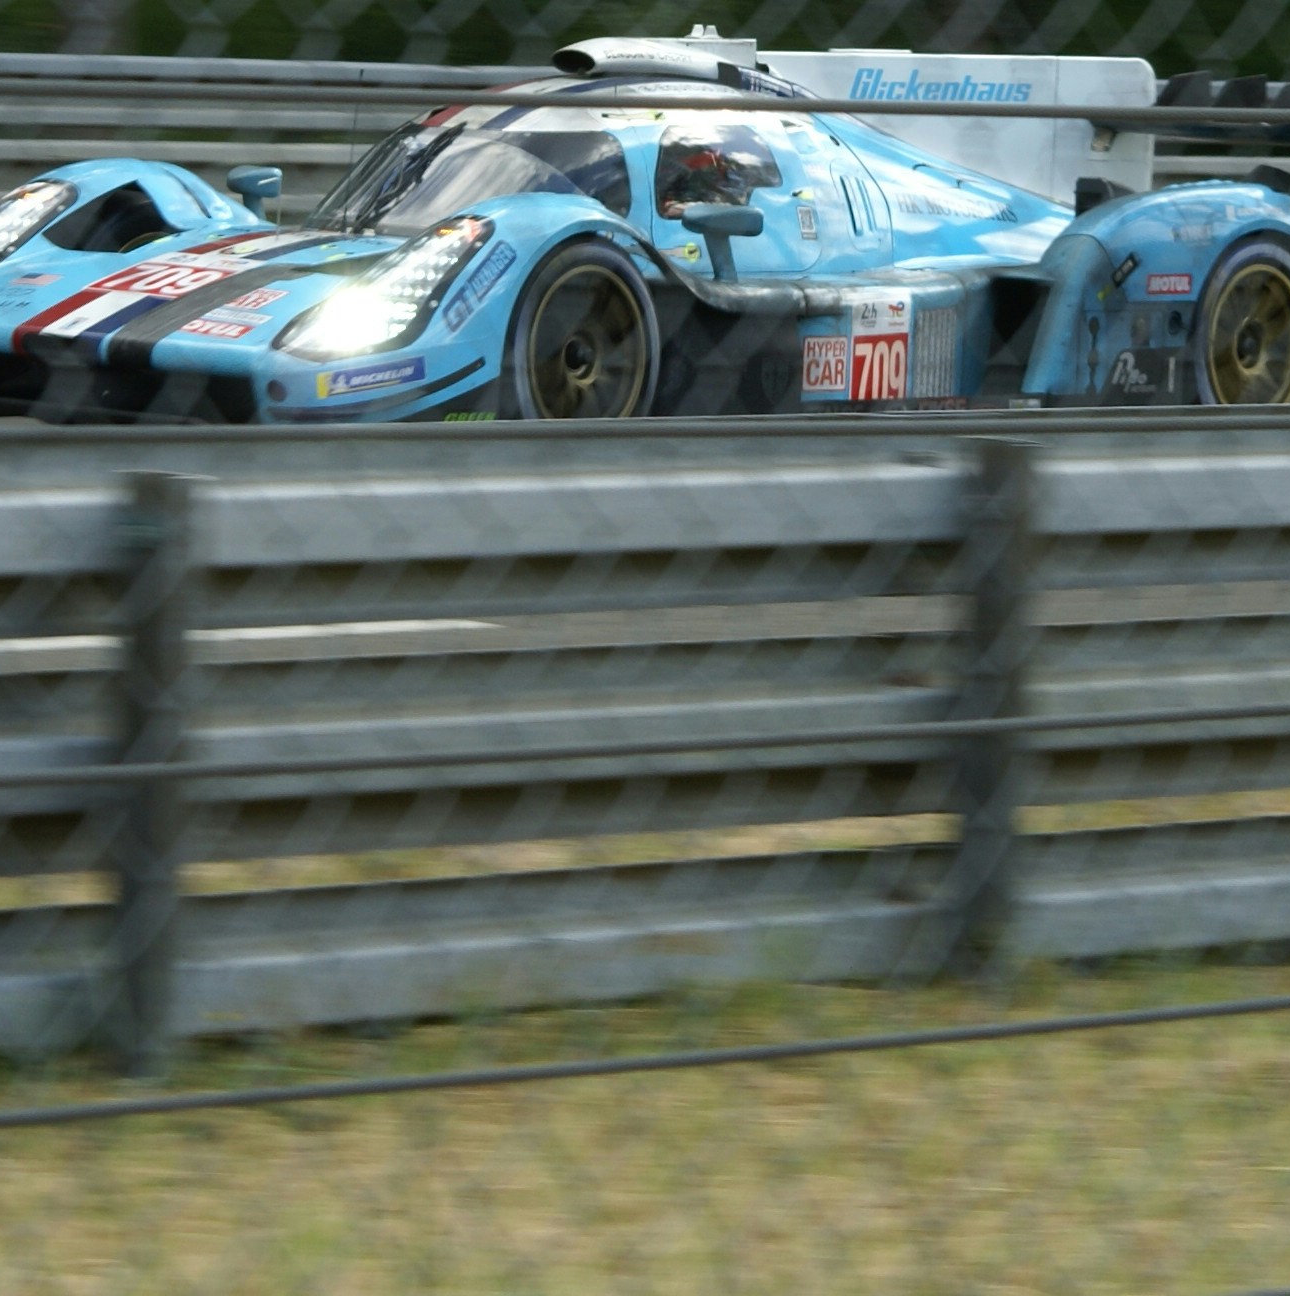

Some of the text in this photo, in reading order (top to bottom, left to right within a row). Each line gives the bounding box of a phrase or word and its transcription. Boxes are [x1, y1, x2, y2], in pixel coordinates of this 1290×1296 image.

[849, 67, 1033, 102] Glickenhaus
[102, 263, 223, 295] 709
[1148, 275, 1191, 292] MOTUL
[181, 318, 245, 337] OTUL
[806, 340, 846, 358] HYPER
[349, 365, 415, 386] MICHELIN
[805, 358, 846, 386] CAR
[854, 339, 906, 401] 709
